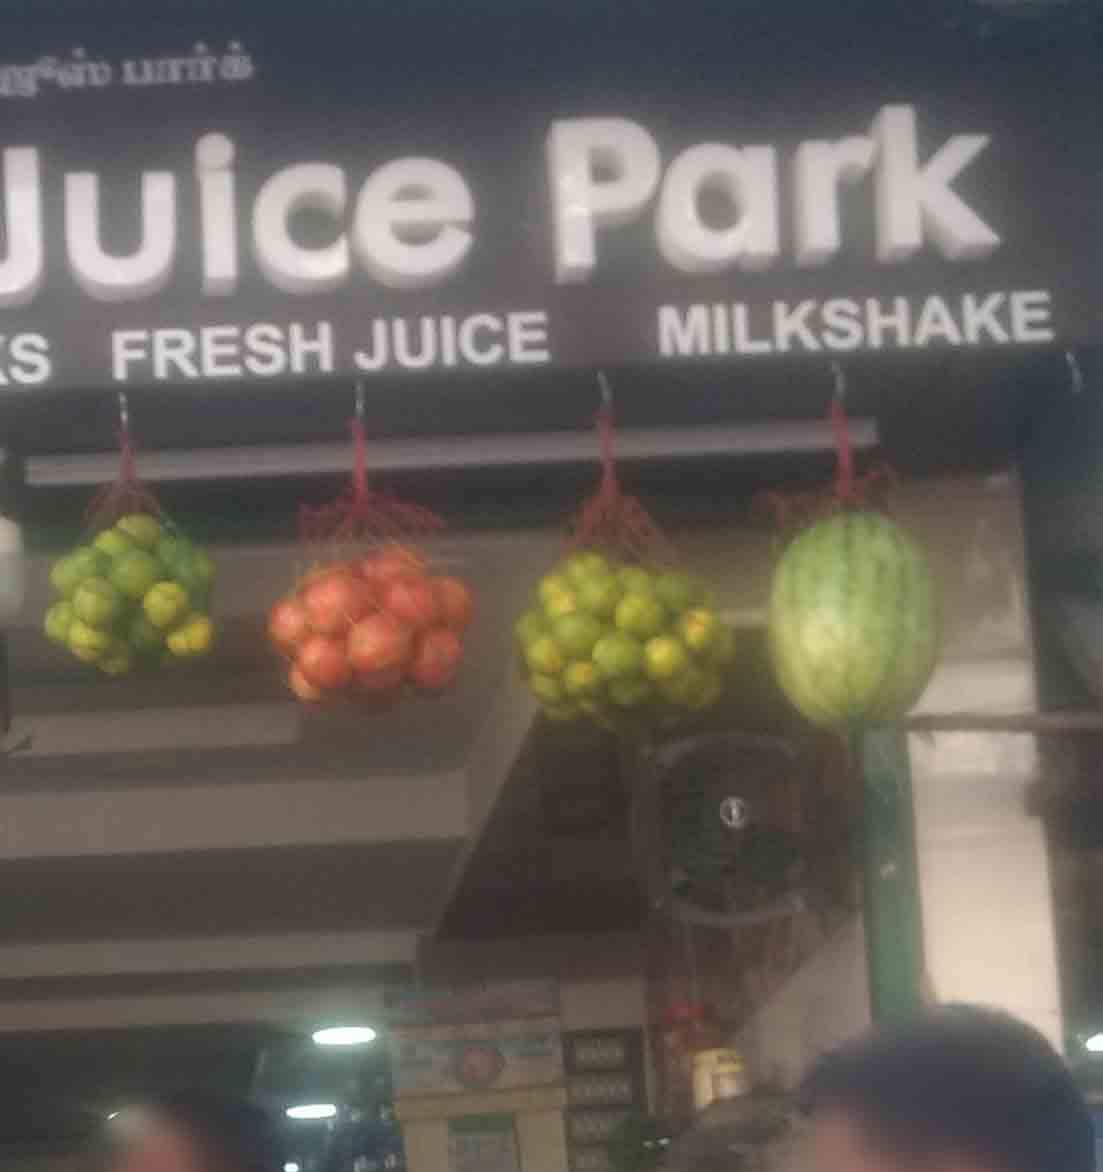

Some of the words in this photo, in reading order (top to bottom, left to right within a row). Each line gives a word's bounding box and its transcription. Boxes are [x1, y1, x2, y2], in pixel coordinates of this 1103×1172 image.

[548, 104, 1002, 284] Park
[111, 322, 334, 380] FRESH
[355, 311, 551, 371] JUICE
[657, 290, 1054, 356] MILKSHAKE
